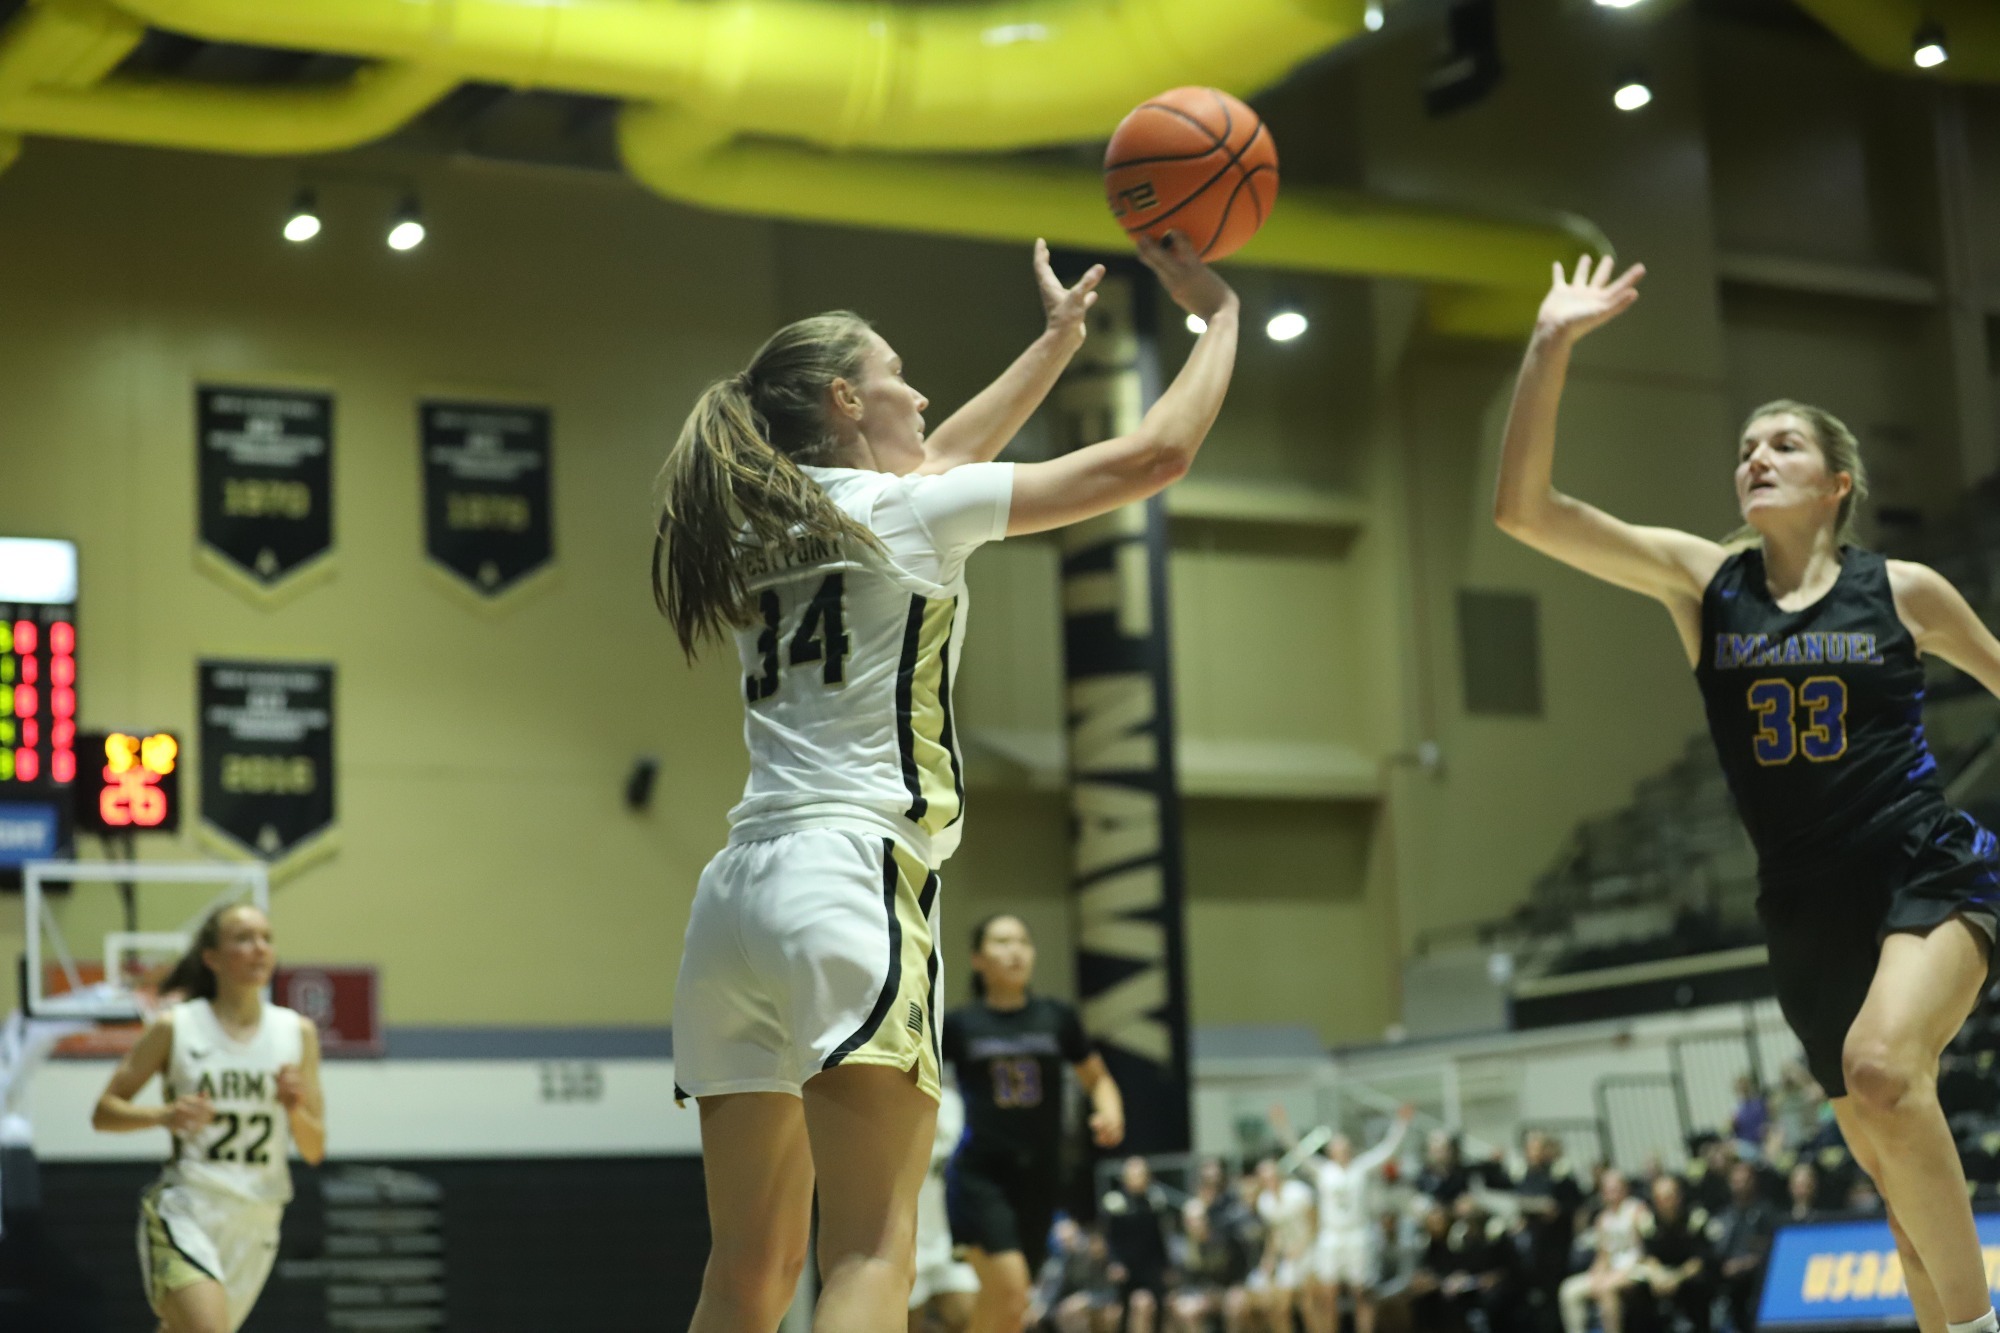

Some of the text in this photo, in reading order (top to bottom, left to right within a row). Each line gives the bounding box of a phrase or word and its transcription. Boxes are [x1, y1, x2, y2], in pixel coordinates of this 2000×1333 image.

[1714, 631, 1885, 670] EMMANUEL
[1747, 676, 1848, 766] 33
[1068, 670, 1172, 1066] NAVY
[199, 1070, 281, 1101] ARM
[206, 1111, 275, 1166] 22
